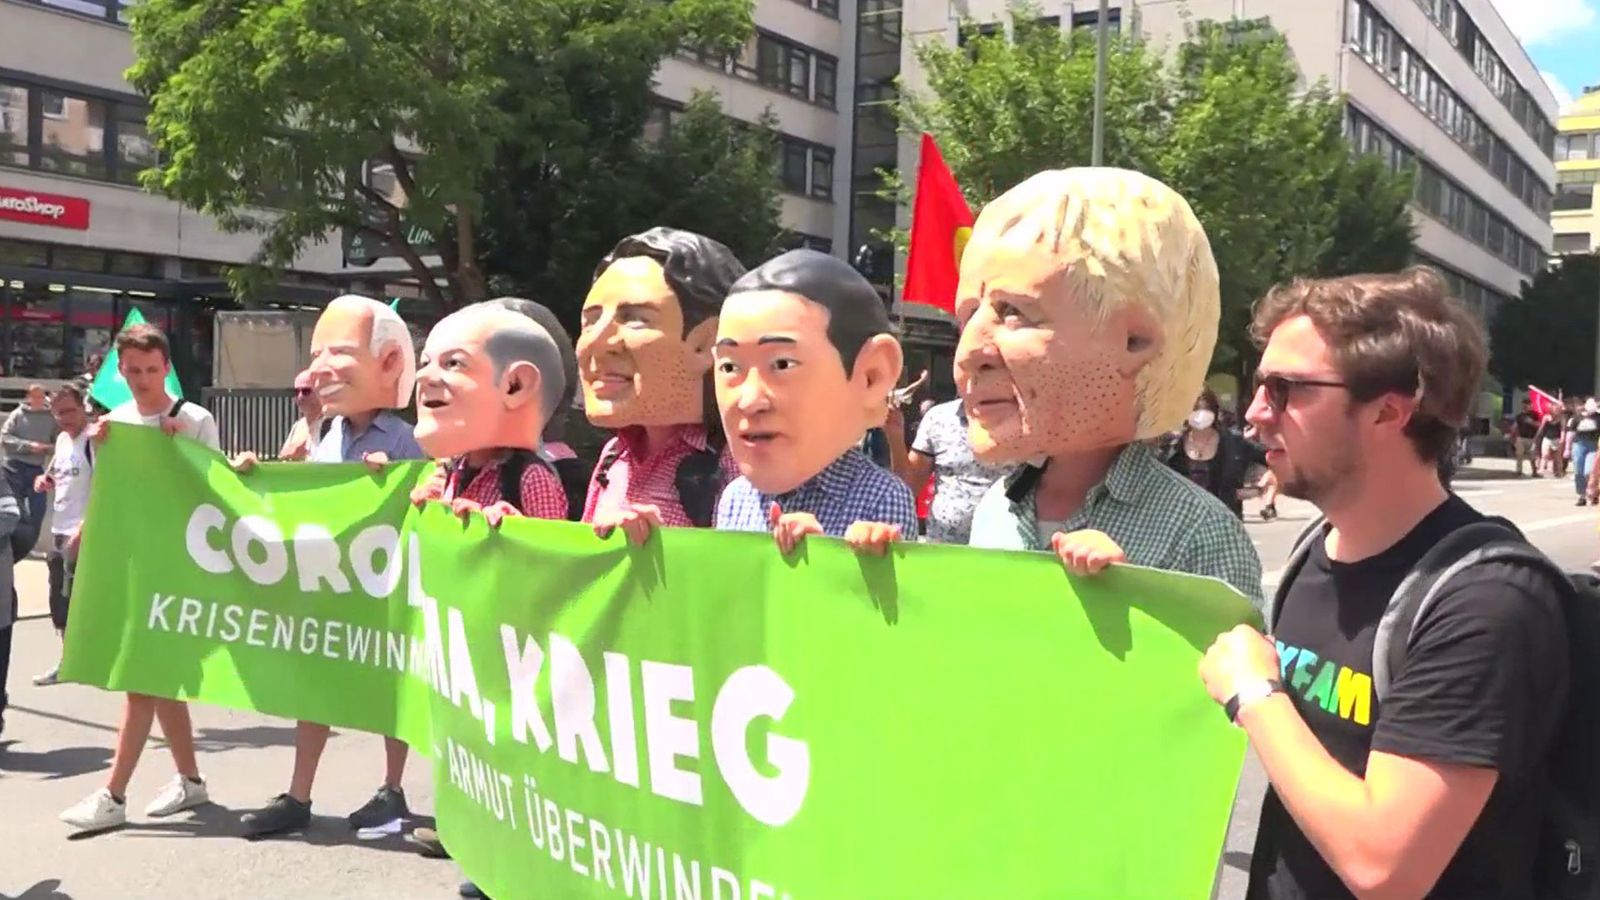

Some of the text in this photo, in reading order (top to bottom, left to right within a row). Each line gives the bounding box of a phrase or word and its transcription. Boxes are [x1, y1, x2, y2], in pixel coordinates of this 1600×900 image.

[500, 622, 811, 827] KRIEG
[1275, 640, 1372, 727] XFAM
[446, 735, 518, 831] ARMUT
[524, 773, 793, 900] ÜBERWIND
